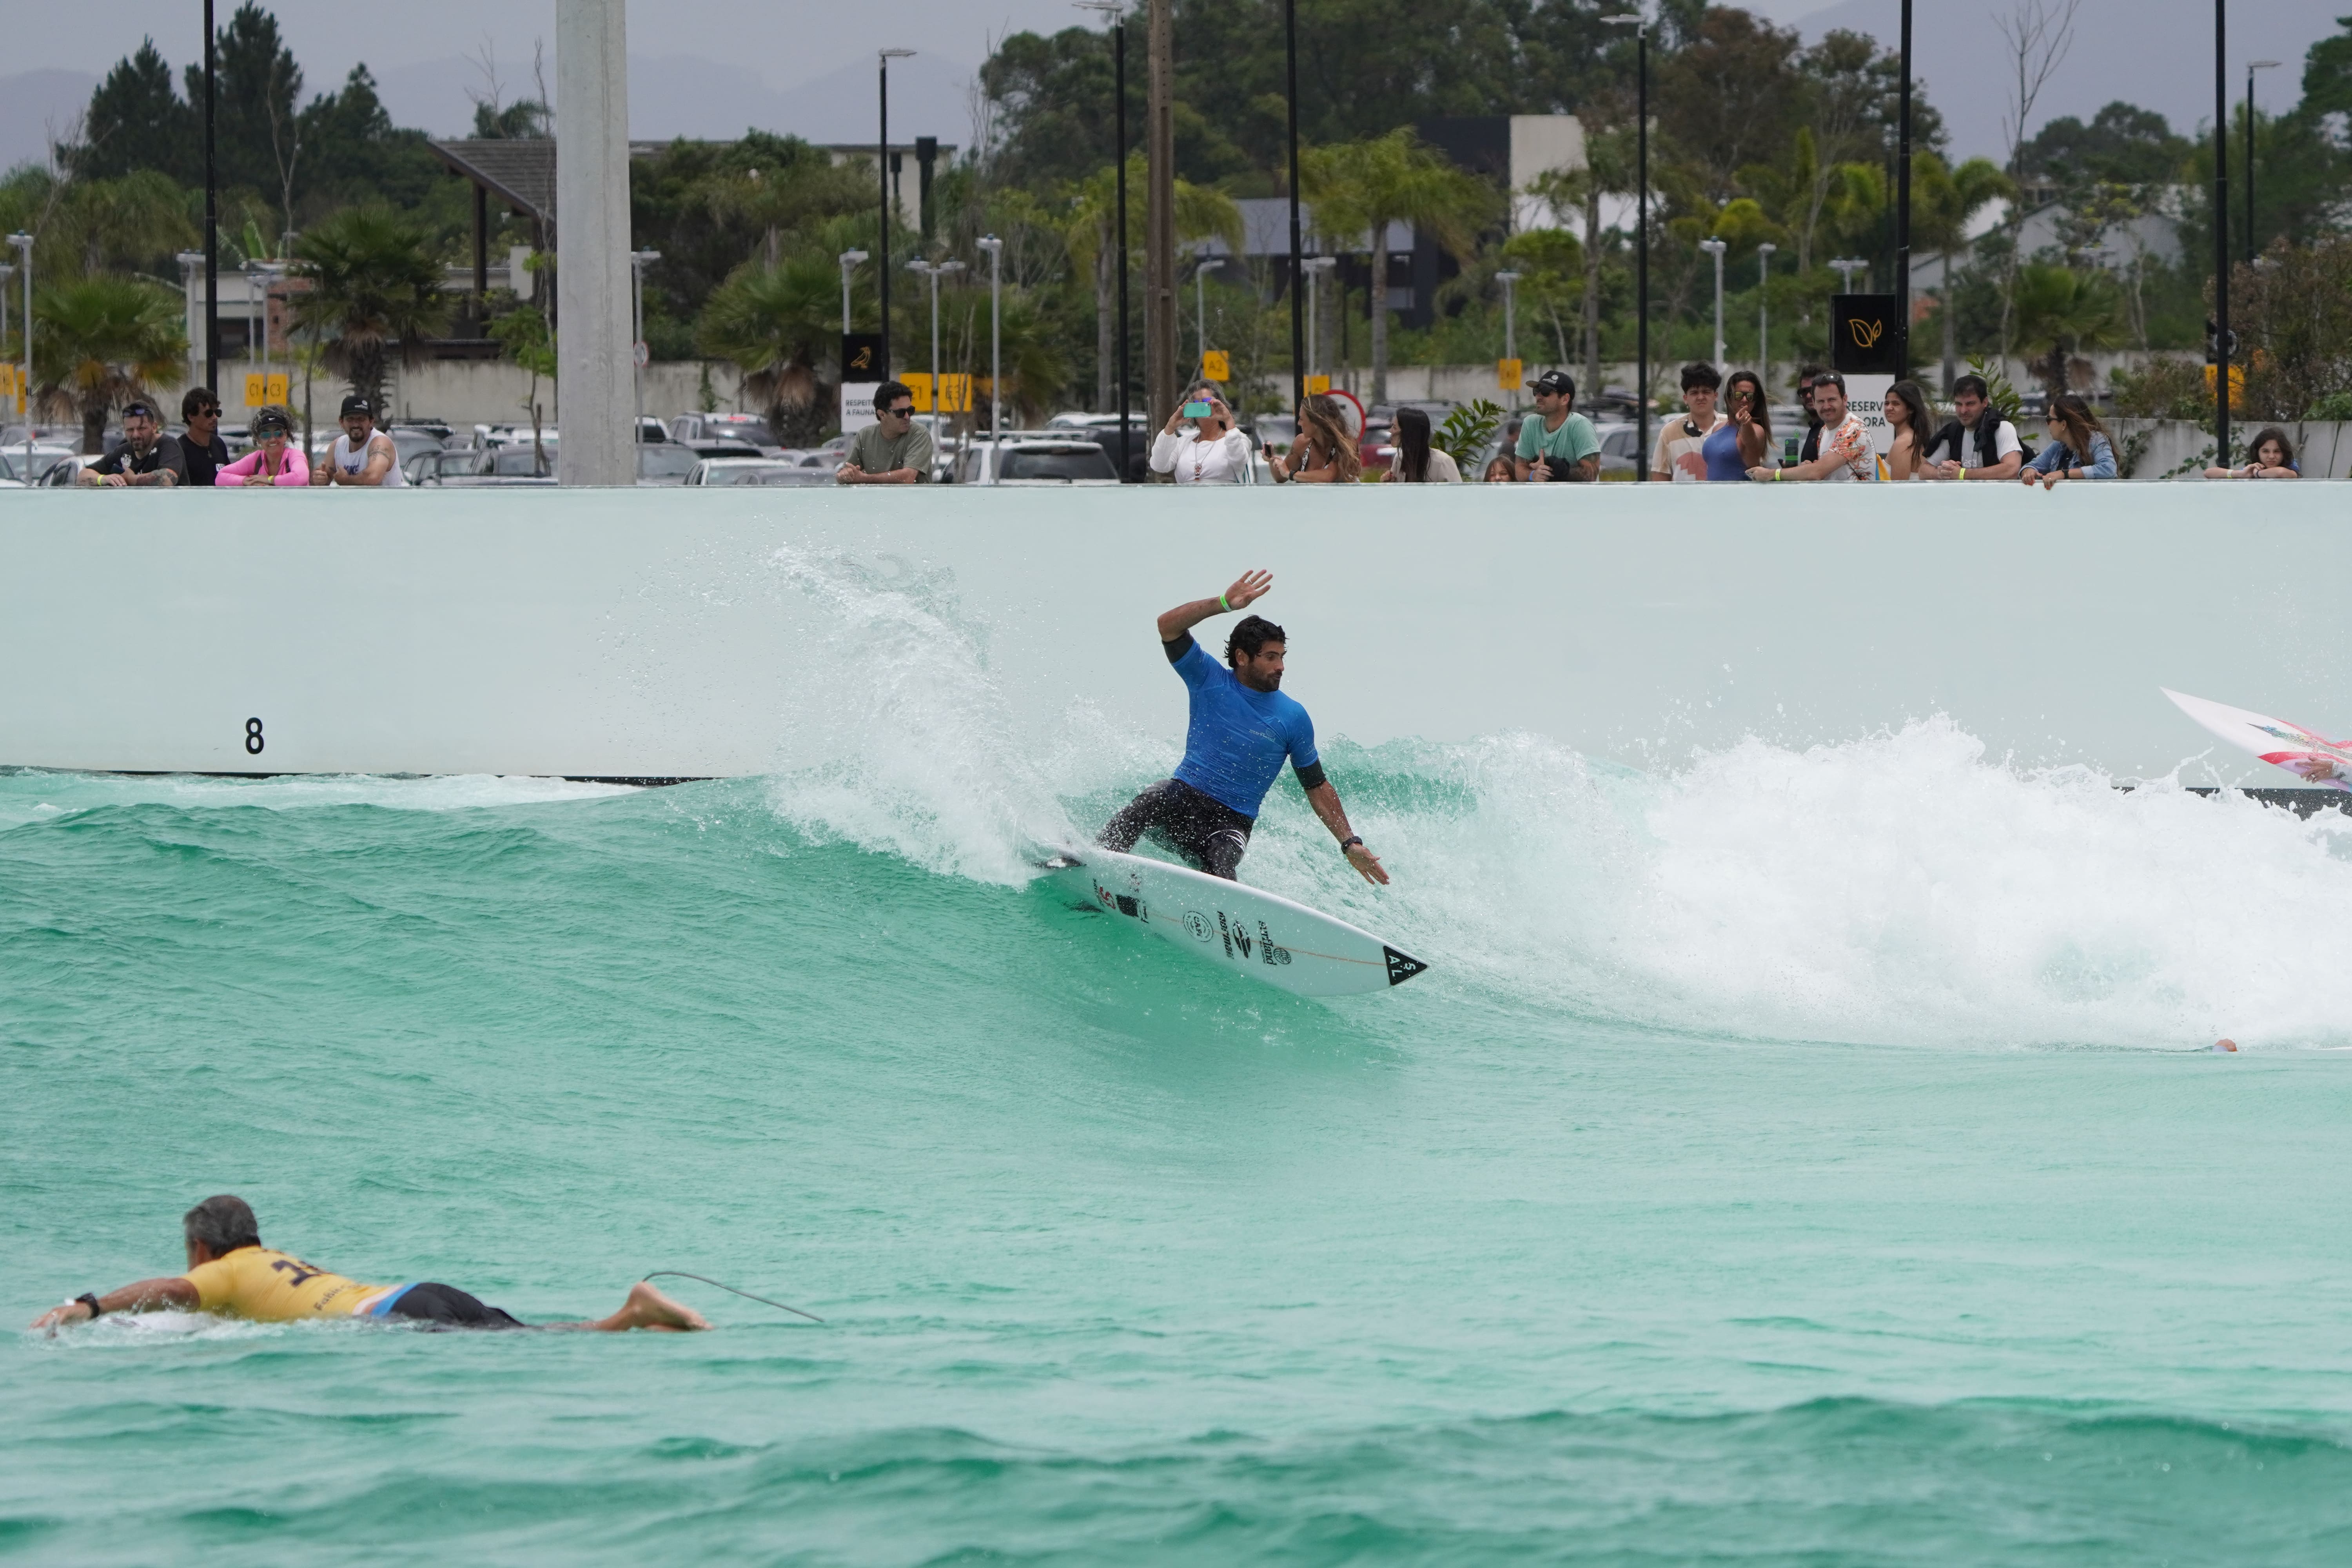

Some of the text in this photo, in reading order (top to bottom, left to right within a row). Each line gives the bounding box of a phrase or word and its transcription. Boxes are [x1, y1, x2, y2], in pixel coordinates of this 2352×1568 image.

[1208, 359, 1223, 371] A2
[249, 383, 258, 396] C1
[270, 383, 280, 396] C3
[245, 717, 264, 754] 8
